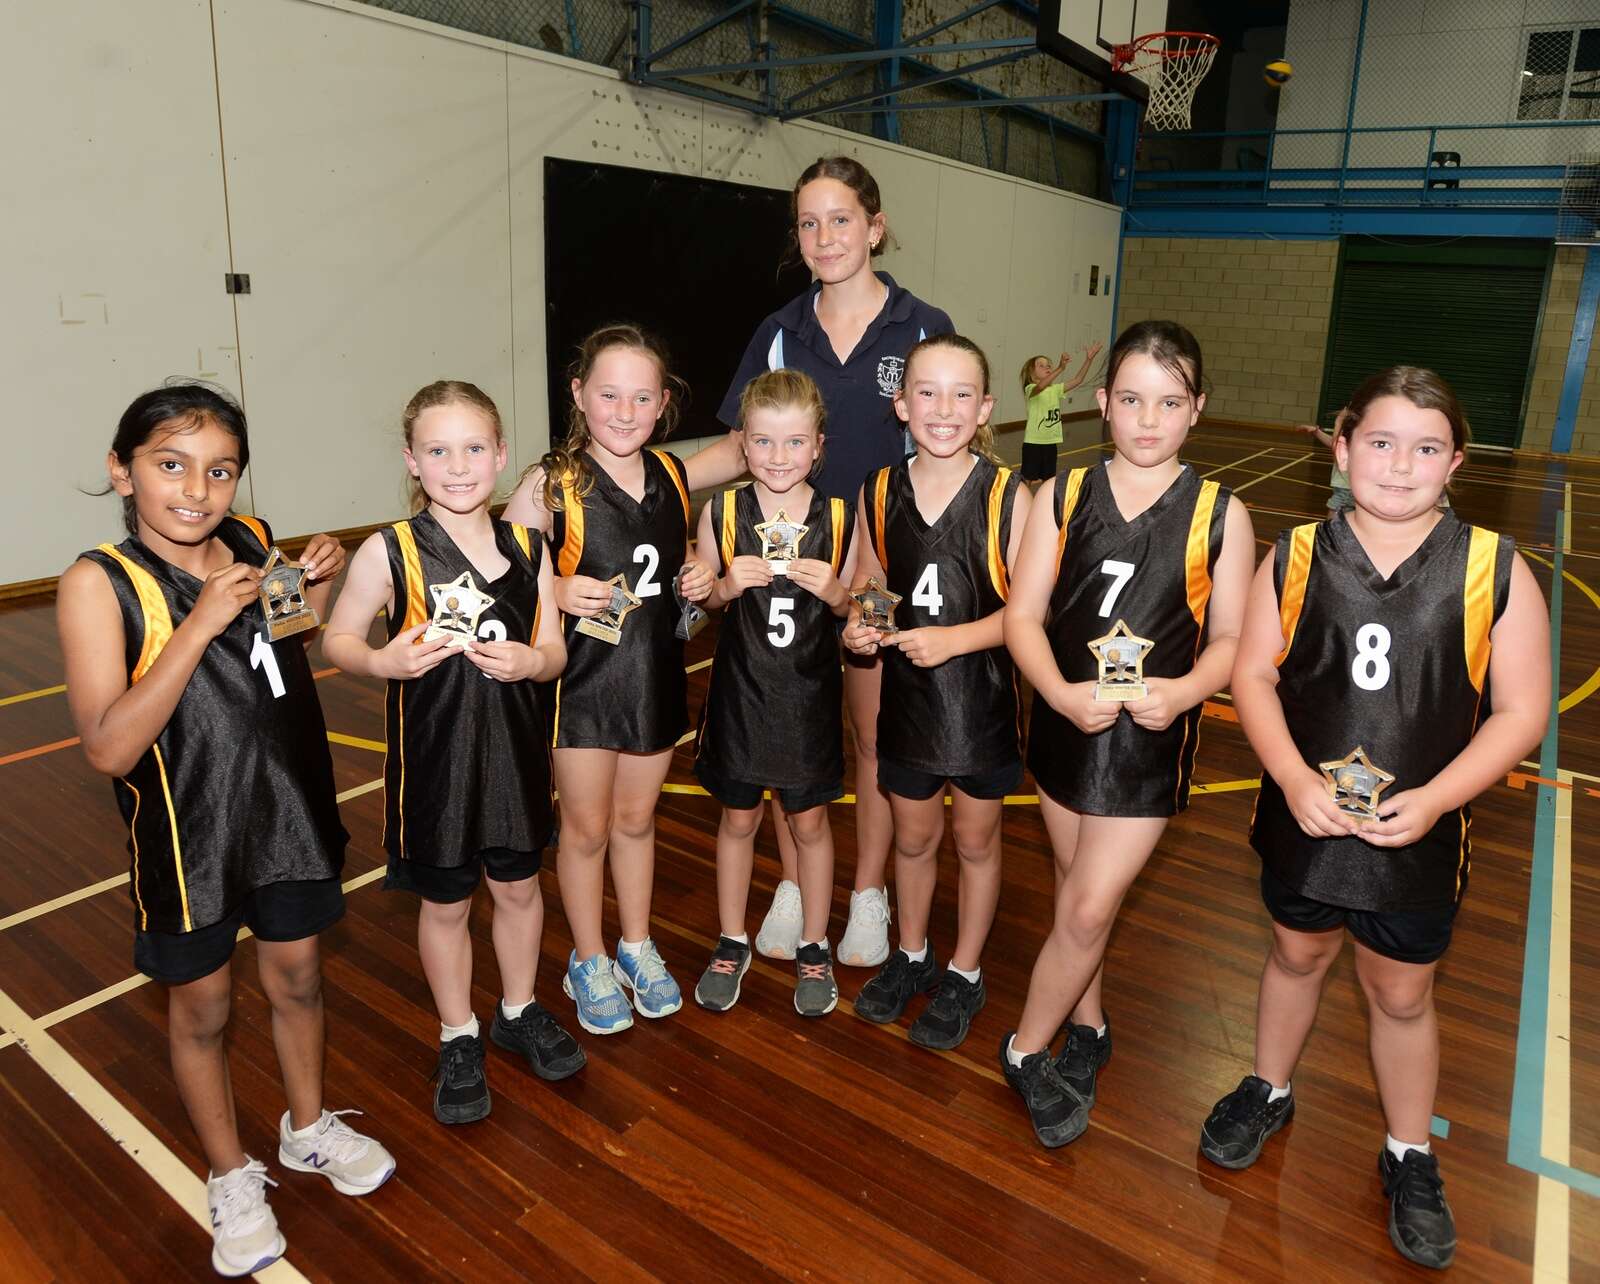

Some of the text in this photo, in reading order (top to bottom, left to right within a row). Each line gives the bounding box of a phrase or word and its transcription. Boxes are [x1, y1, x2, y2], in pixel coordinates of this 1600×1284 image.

[632, 543, 662, 598] 2
[911, 563, 943, 616] 4
[1098, 559, 1136, 618] 7
[767, 597, 795, 648] 5
[249, 631, 287, 699] 1
[1351, 622, 1391, 691] 8
